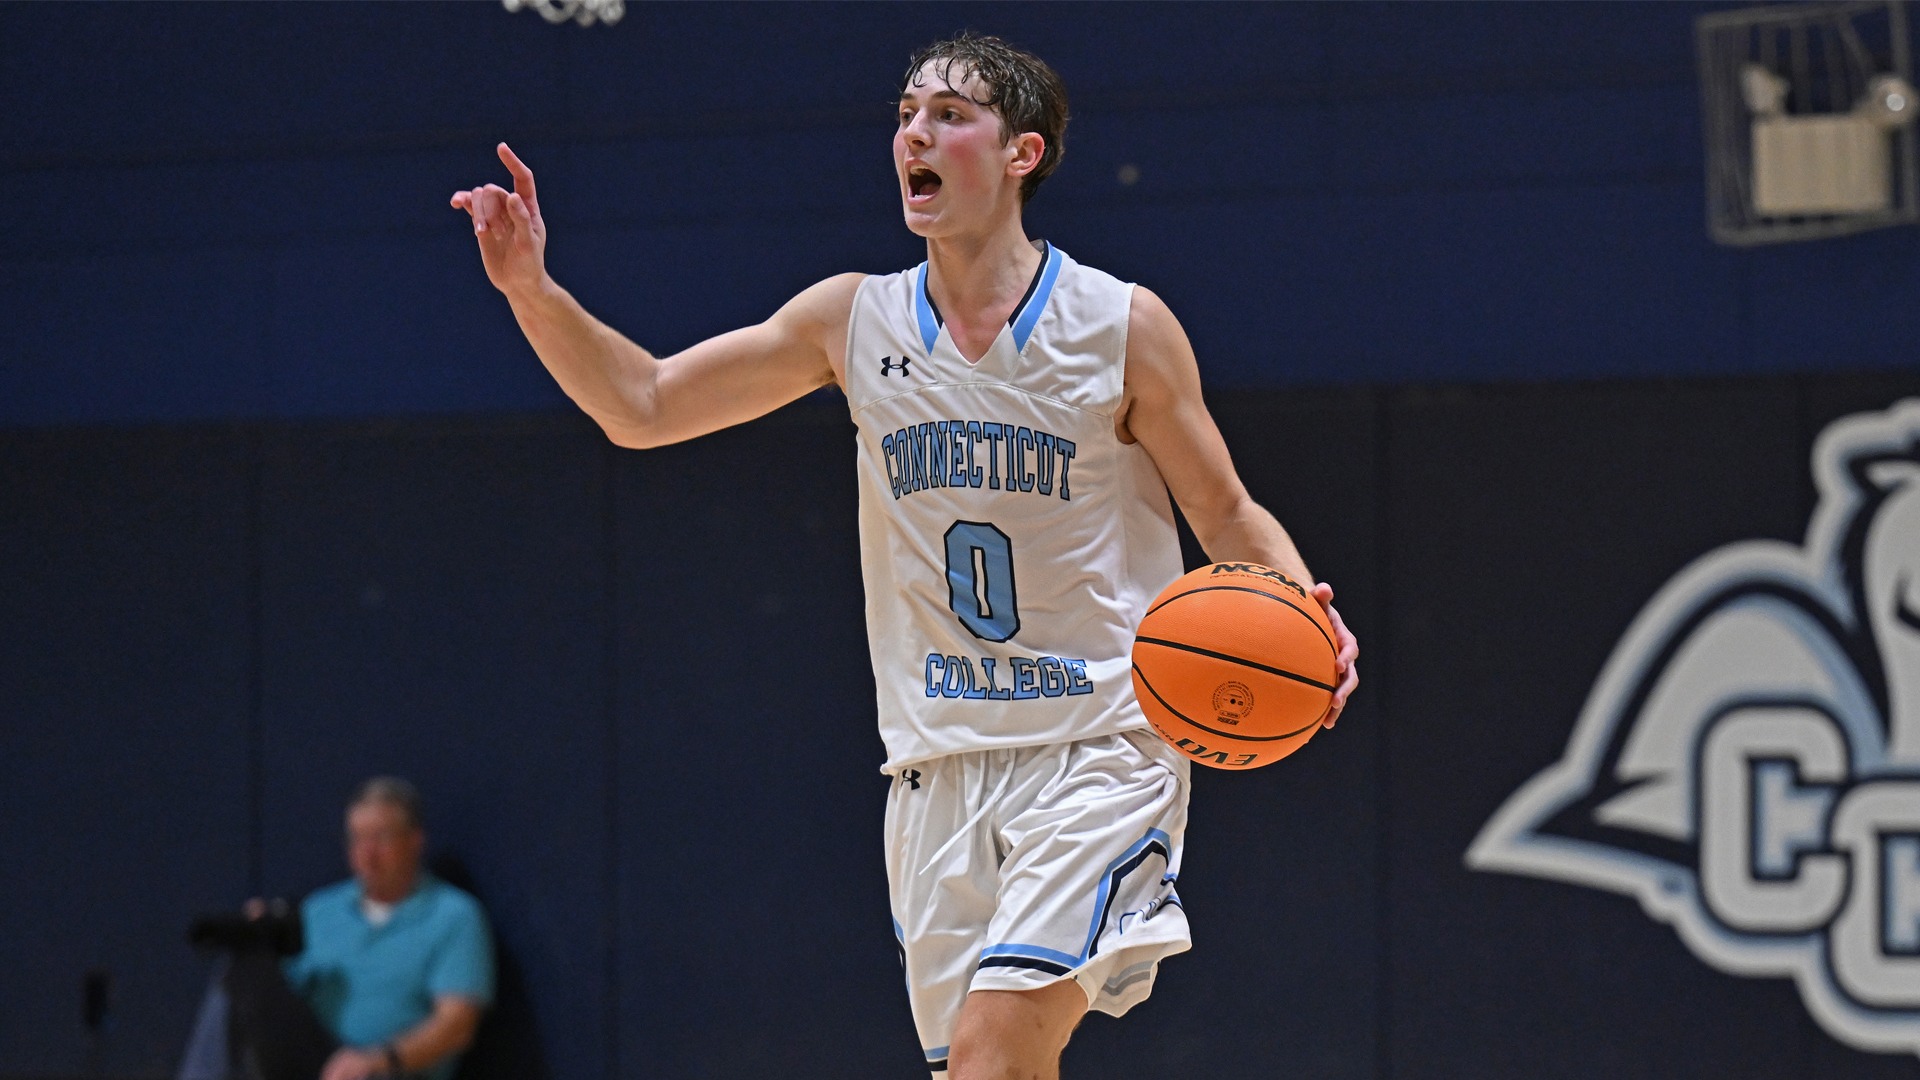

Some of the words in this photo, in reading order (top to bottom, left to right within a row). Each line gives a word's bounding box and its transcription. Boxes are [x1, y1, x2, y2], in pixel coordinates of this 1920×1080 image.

[881, 420, 1076, 501] CONNECTICUT
[943, 519, 1021, 643] 0
[1211, 563, 1307, 599] NCAA
[925, 653, 1094, 700] COLLEGE
[1175, 738, 1258, 766] EVO
